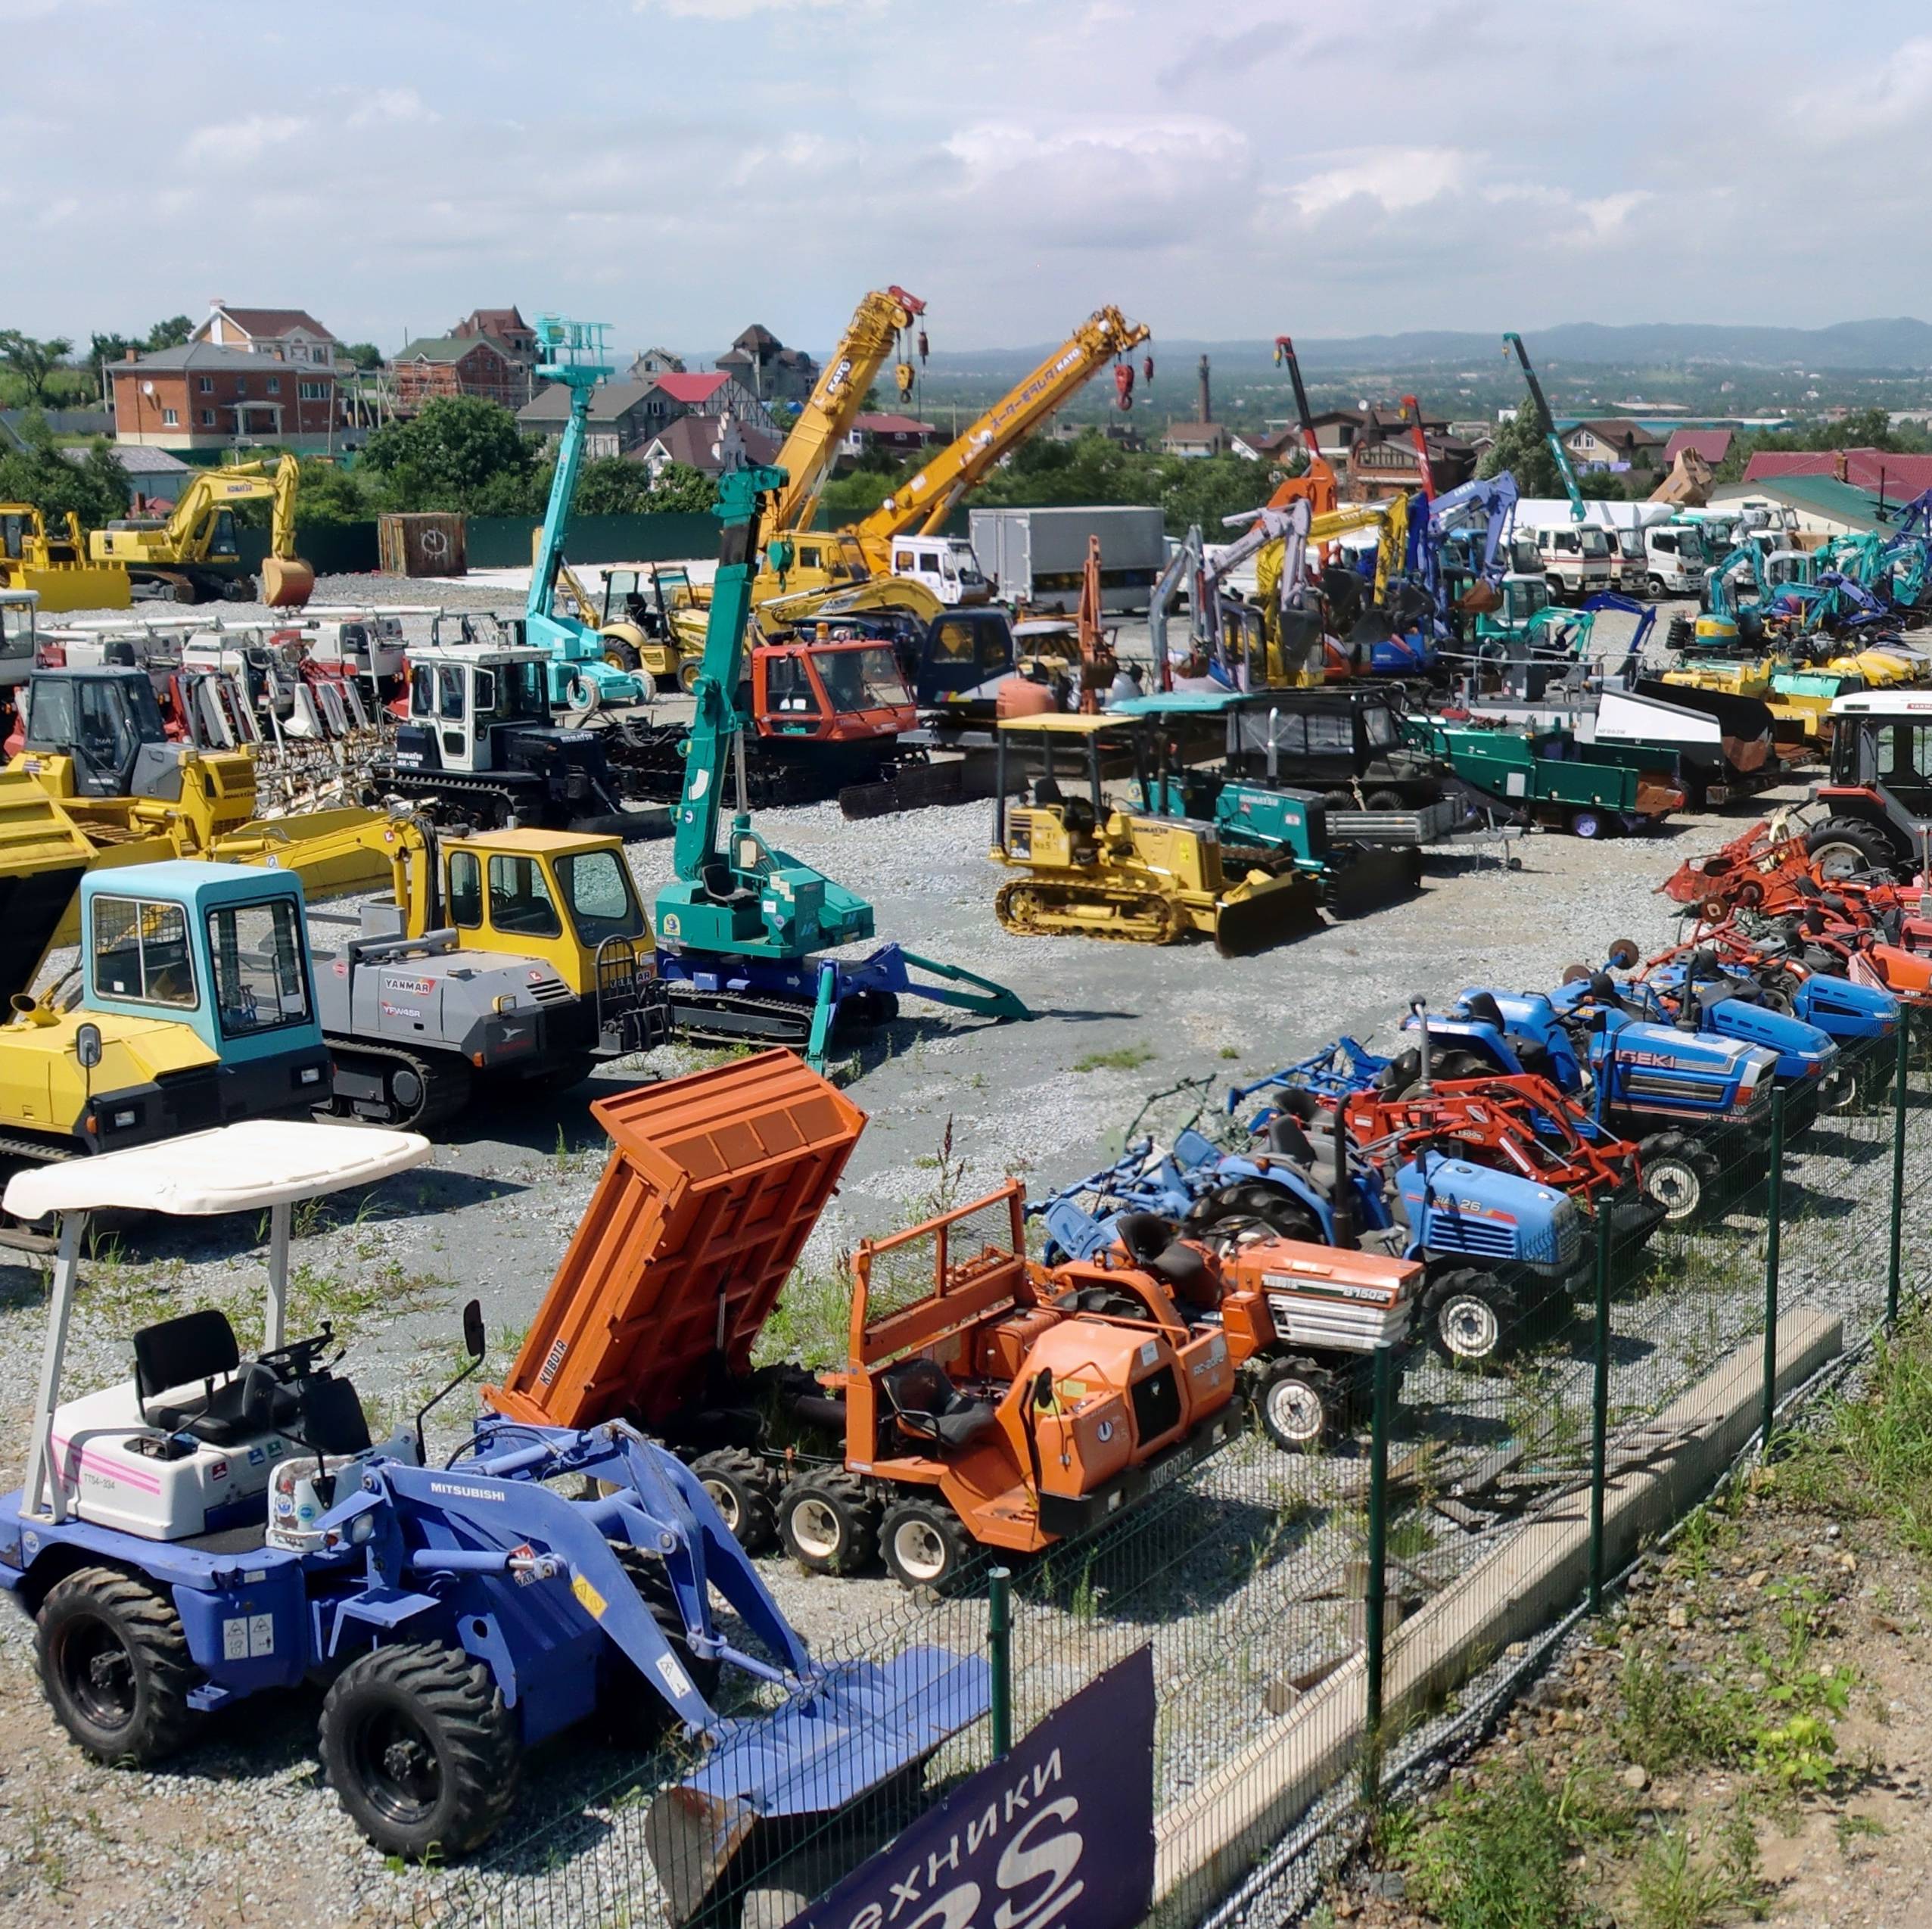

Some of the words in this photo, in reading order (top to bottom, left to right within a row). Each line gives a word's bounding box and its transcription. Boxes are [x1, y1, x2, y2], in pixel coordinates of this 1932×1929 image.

[1056, 347, 1081, 372] KATO
[827, 361, 851, 393] KATO
[1238, 792, 1279, 807] KOMATSU
[1132, 826, 1168, 835] KOMATSU
[384, 978, 429, 994] YANMAR
[1614, 1049, 1675, 1069] ISEKI
[1460, 1198, 1482, 1212] 26
[540, 1339, 567, 1386] KUBOTA
[430, 1482, 506, 1502] MITSUBISHI
[808, 1747, 1062, 1929] ехники
